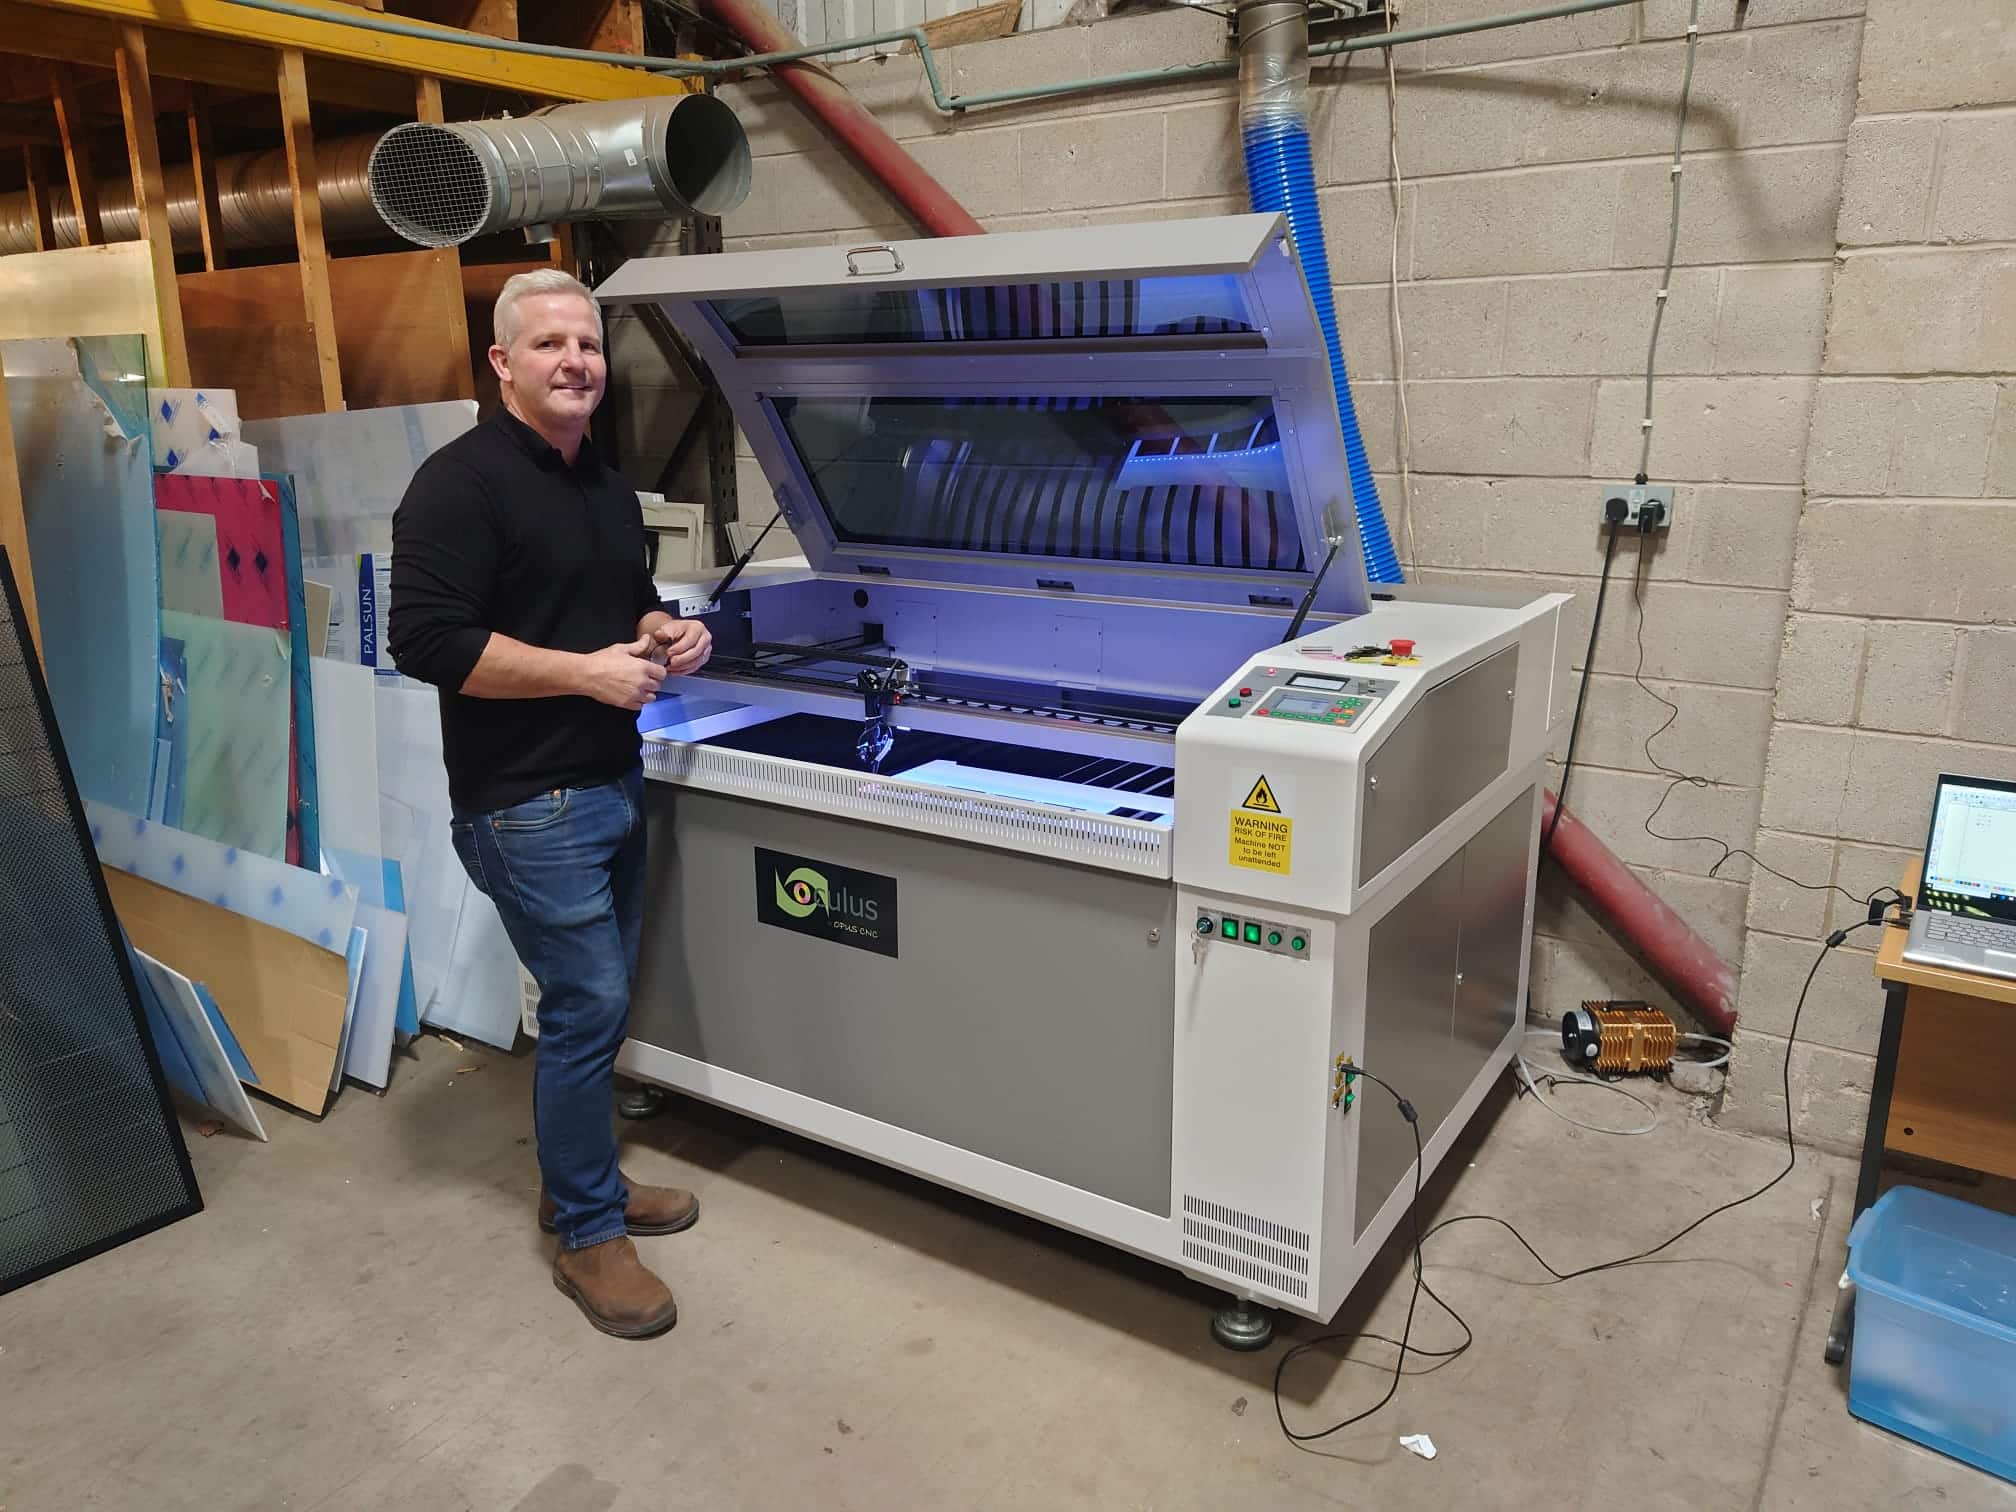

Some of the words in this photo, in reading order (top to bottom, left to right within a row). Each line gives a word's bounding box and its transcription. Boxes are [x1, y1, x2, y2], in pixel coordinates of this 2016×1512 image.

[361, 588, 374, 654] PALSUN
[1235, 816, 1288, 833] WARNING
[1234, 827, 1253, 836] RISK
[1268, 833, 1287, 841] FIRE
[1235, 837, 1266, 848] Machine
[1268, 843, 1286, 852] NOT
[1238, 856, 1281, 867] unattended
[859, 928, 879, 939] CNC
